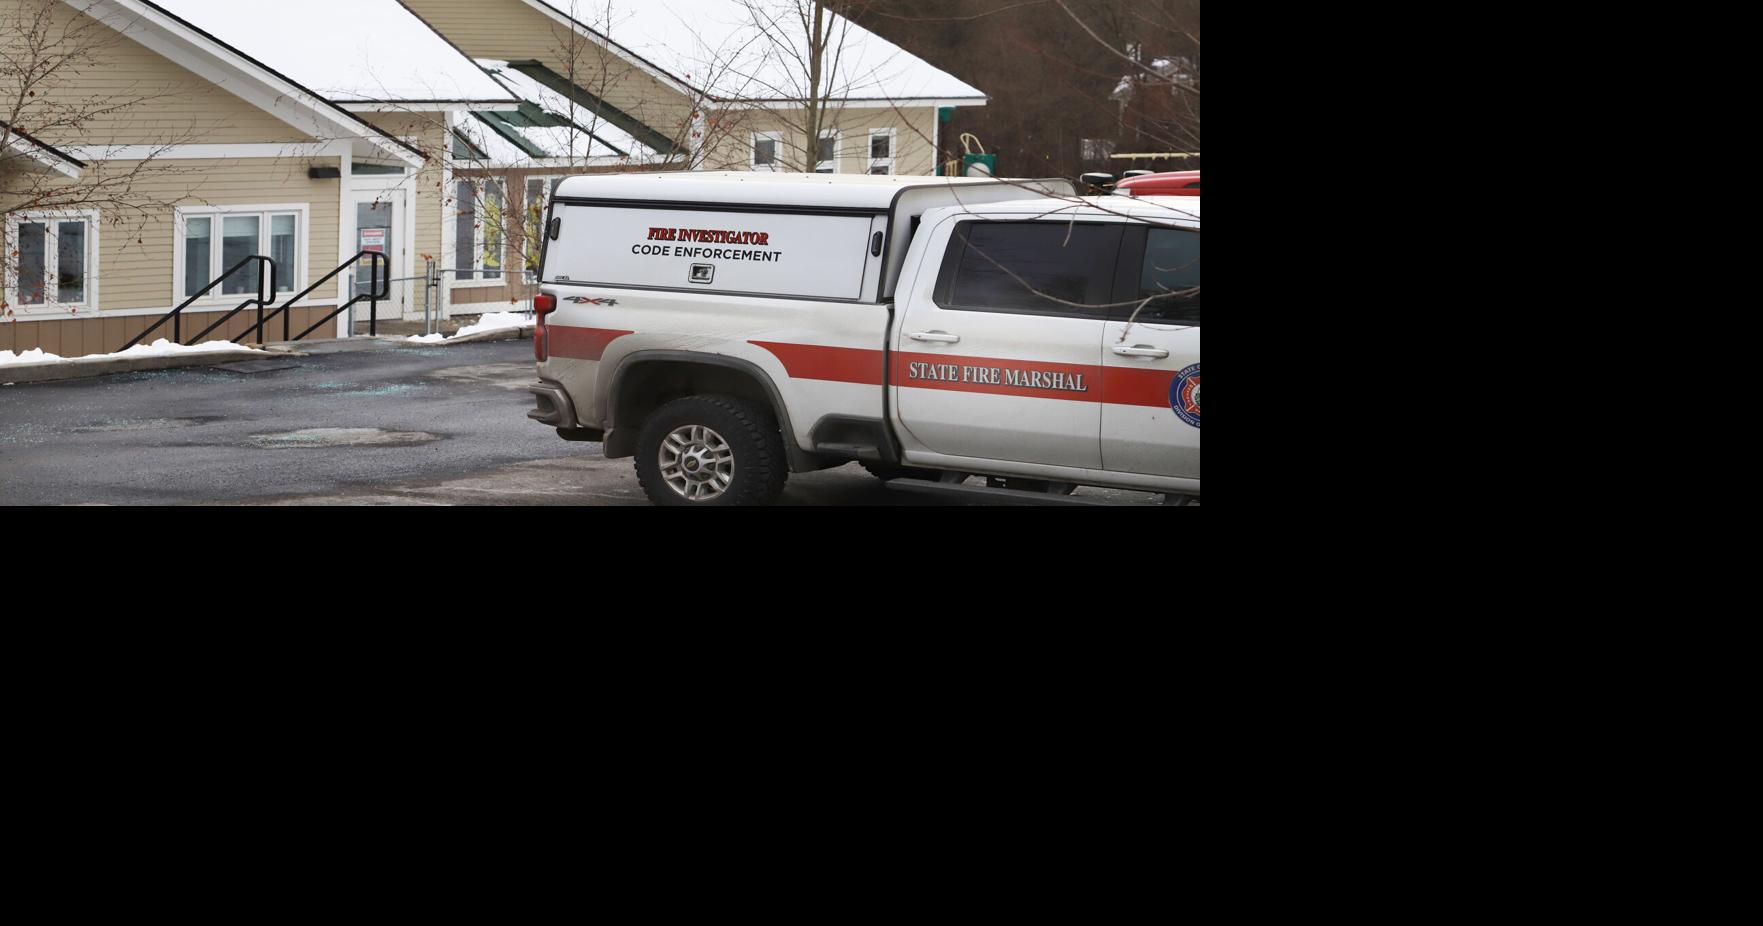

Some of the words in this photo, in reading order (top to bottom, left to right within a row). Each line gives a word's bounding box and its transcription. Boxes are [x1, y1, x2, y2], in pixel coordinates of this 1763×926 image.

[647, 227, 677, 241] FIRE
[678, 228, 769, 245] INVESTIGATOR
[631, 244, 671, 256] CODE
[674, 246, 782, 262] ENFORCEMENT
[909, 361, 959, 381] STATE
[962, 366, 1001, 385] FIRE
[1004, 368, 1088, 393] MARSHAL
[1174, 404, 1195, 425] DIVISION
